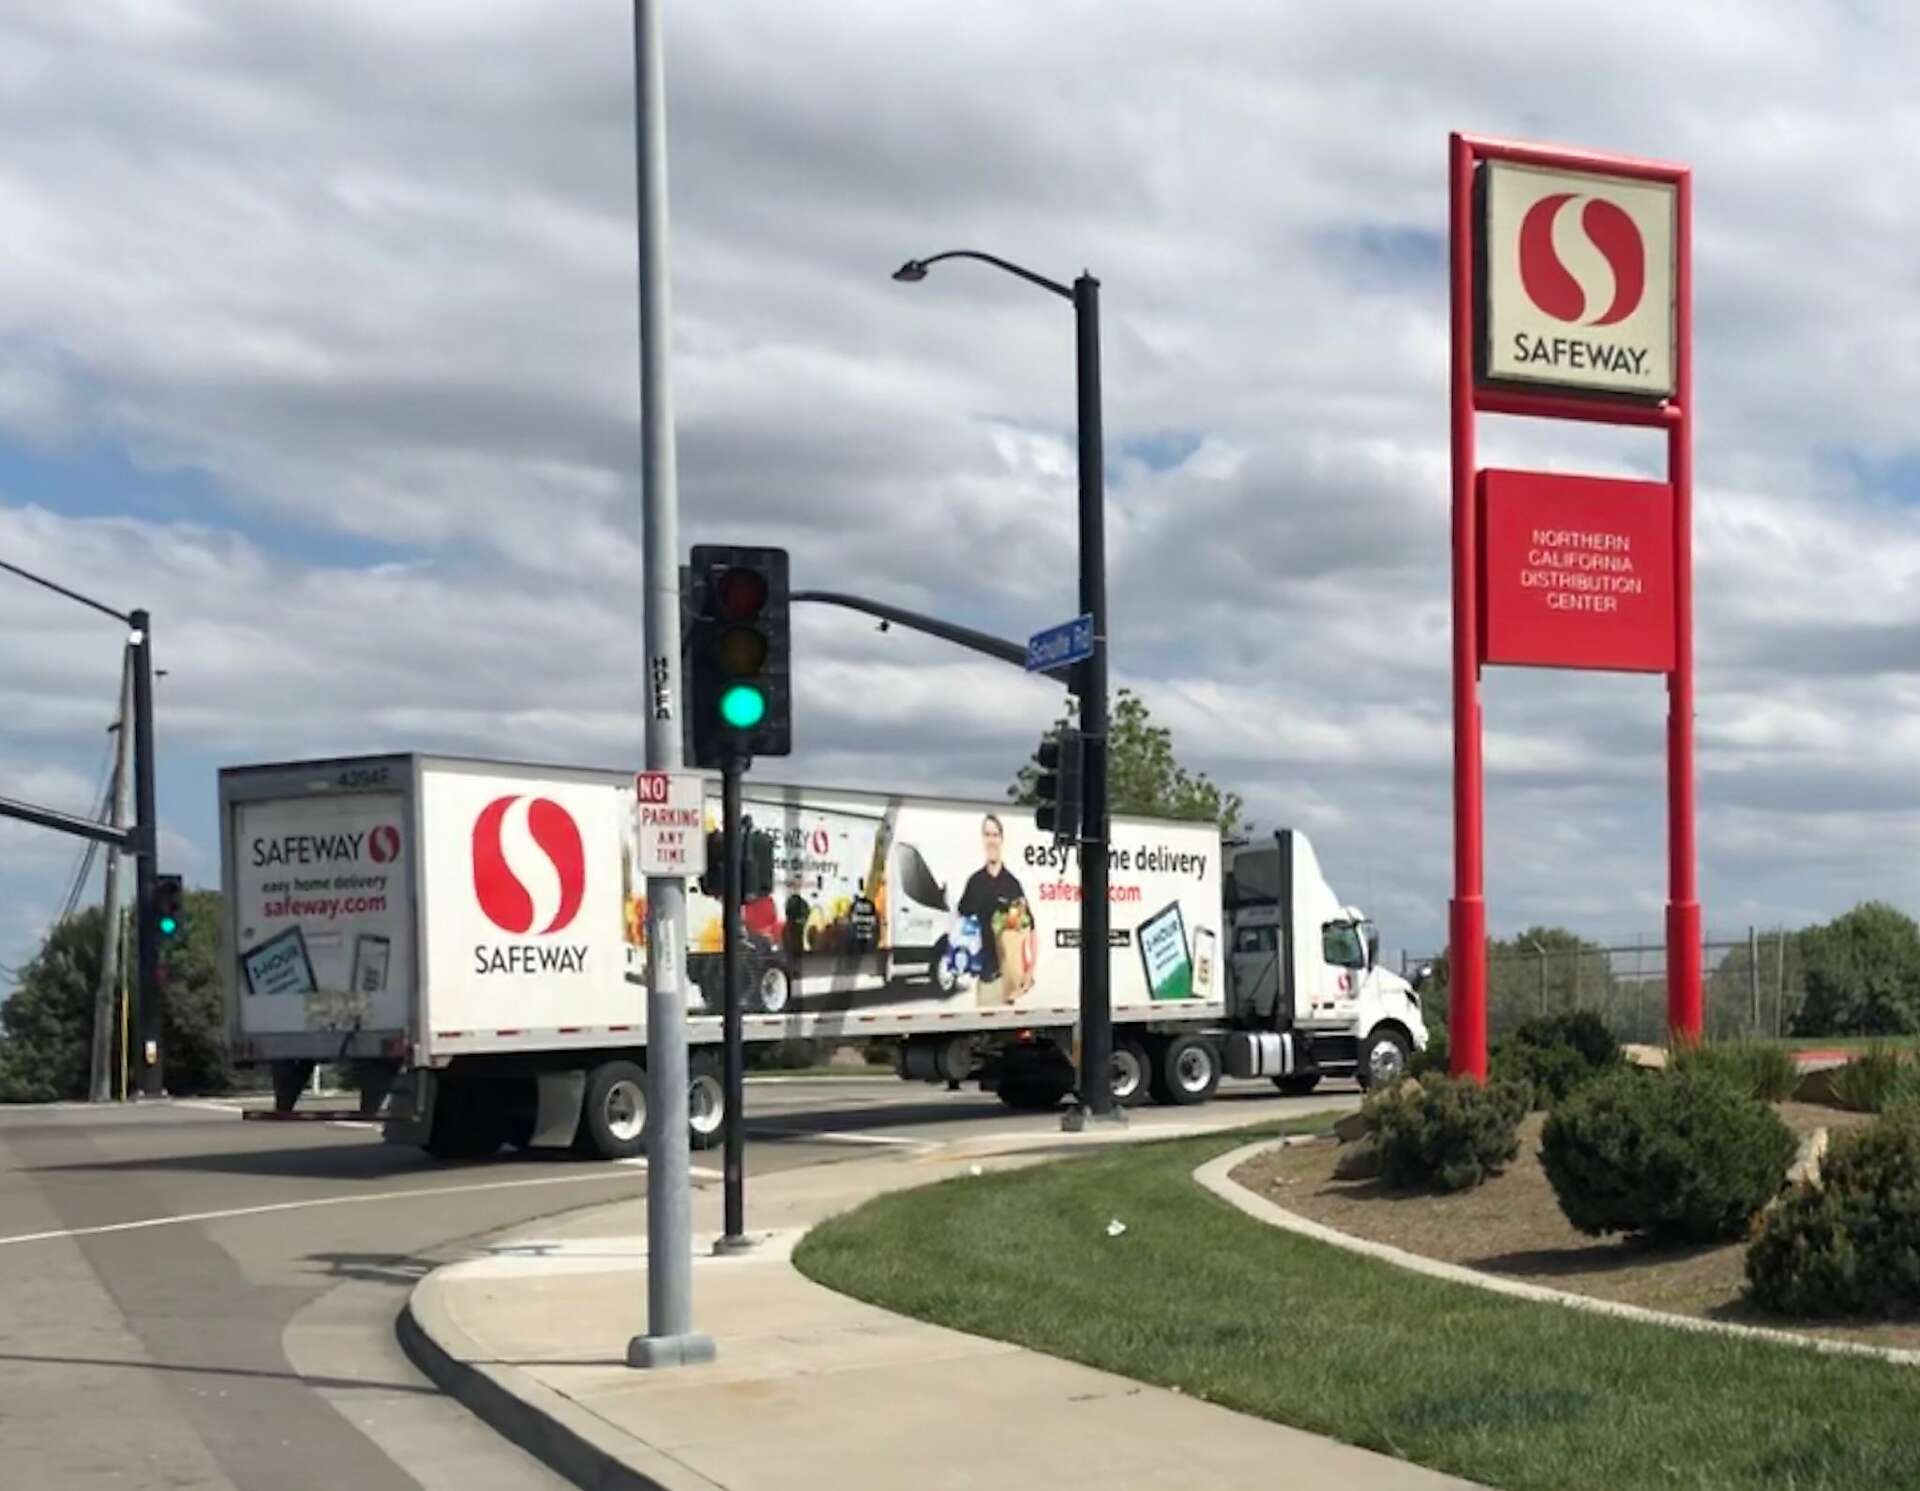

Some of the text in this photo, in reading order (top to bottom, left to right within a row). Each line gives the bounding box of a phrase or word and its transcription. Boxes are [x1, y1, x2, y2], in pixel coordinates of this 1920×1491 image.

[1513, 332, 1648, 375] SAFEWAY
[1532, 528, 1631, 551] NORTHERN
[1528, 549, 1633, 571] CALIFORNIA
[1520, 569, 1643, 593] DISTRIBUTION
[1546, 591, 1617, 612] CENTER
[640, 775, 666, 801] NO
[642, 807, 700, 828] PARKING
[252, 832, 364, 867] SAFEWAY
[657, 831, 685, 845] ANY
[657, 848, 686, 863] TIME
[1024, 843, 1070, 875] easy
[1135, 844, 1207, 881] delivery
[262, 874, 387, 897] easy home delivery
[264, 895, 387, 920] safeway.com
[474, 943, 590, 975] SAFEWAY
